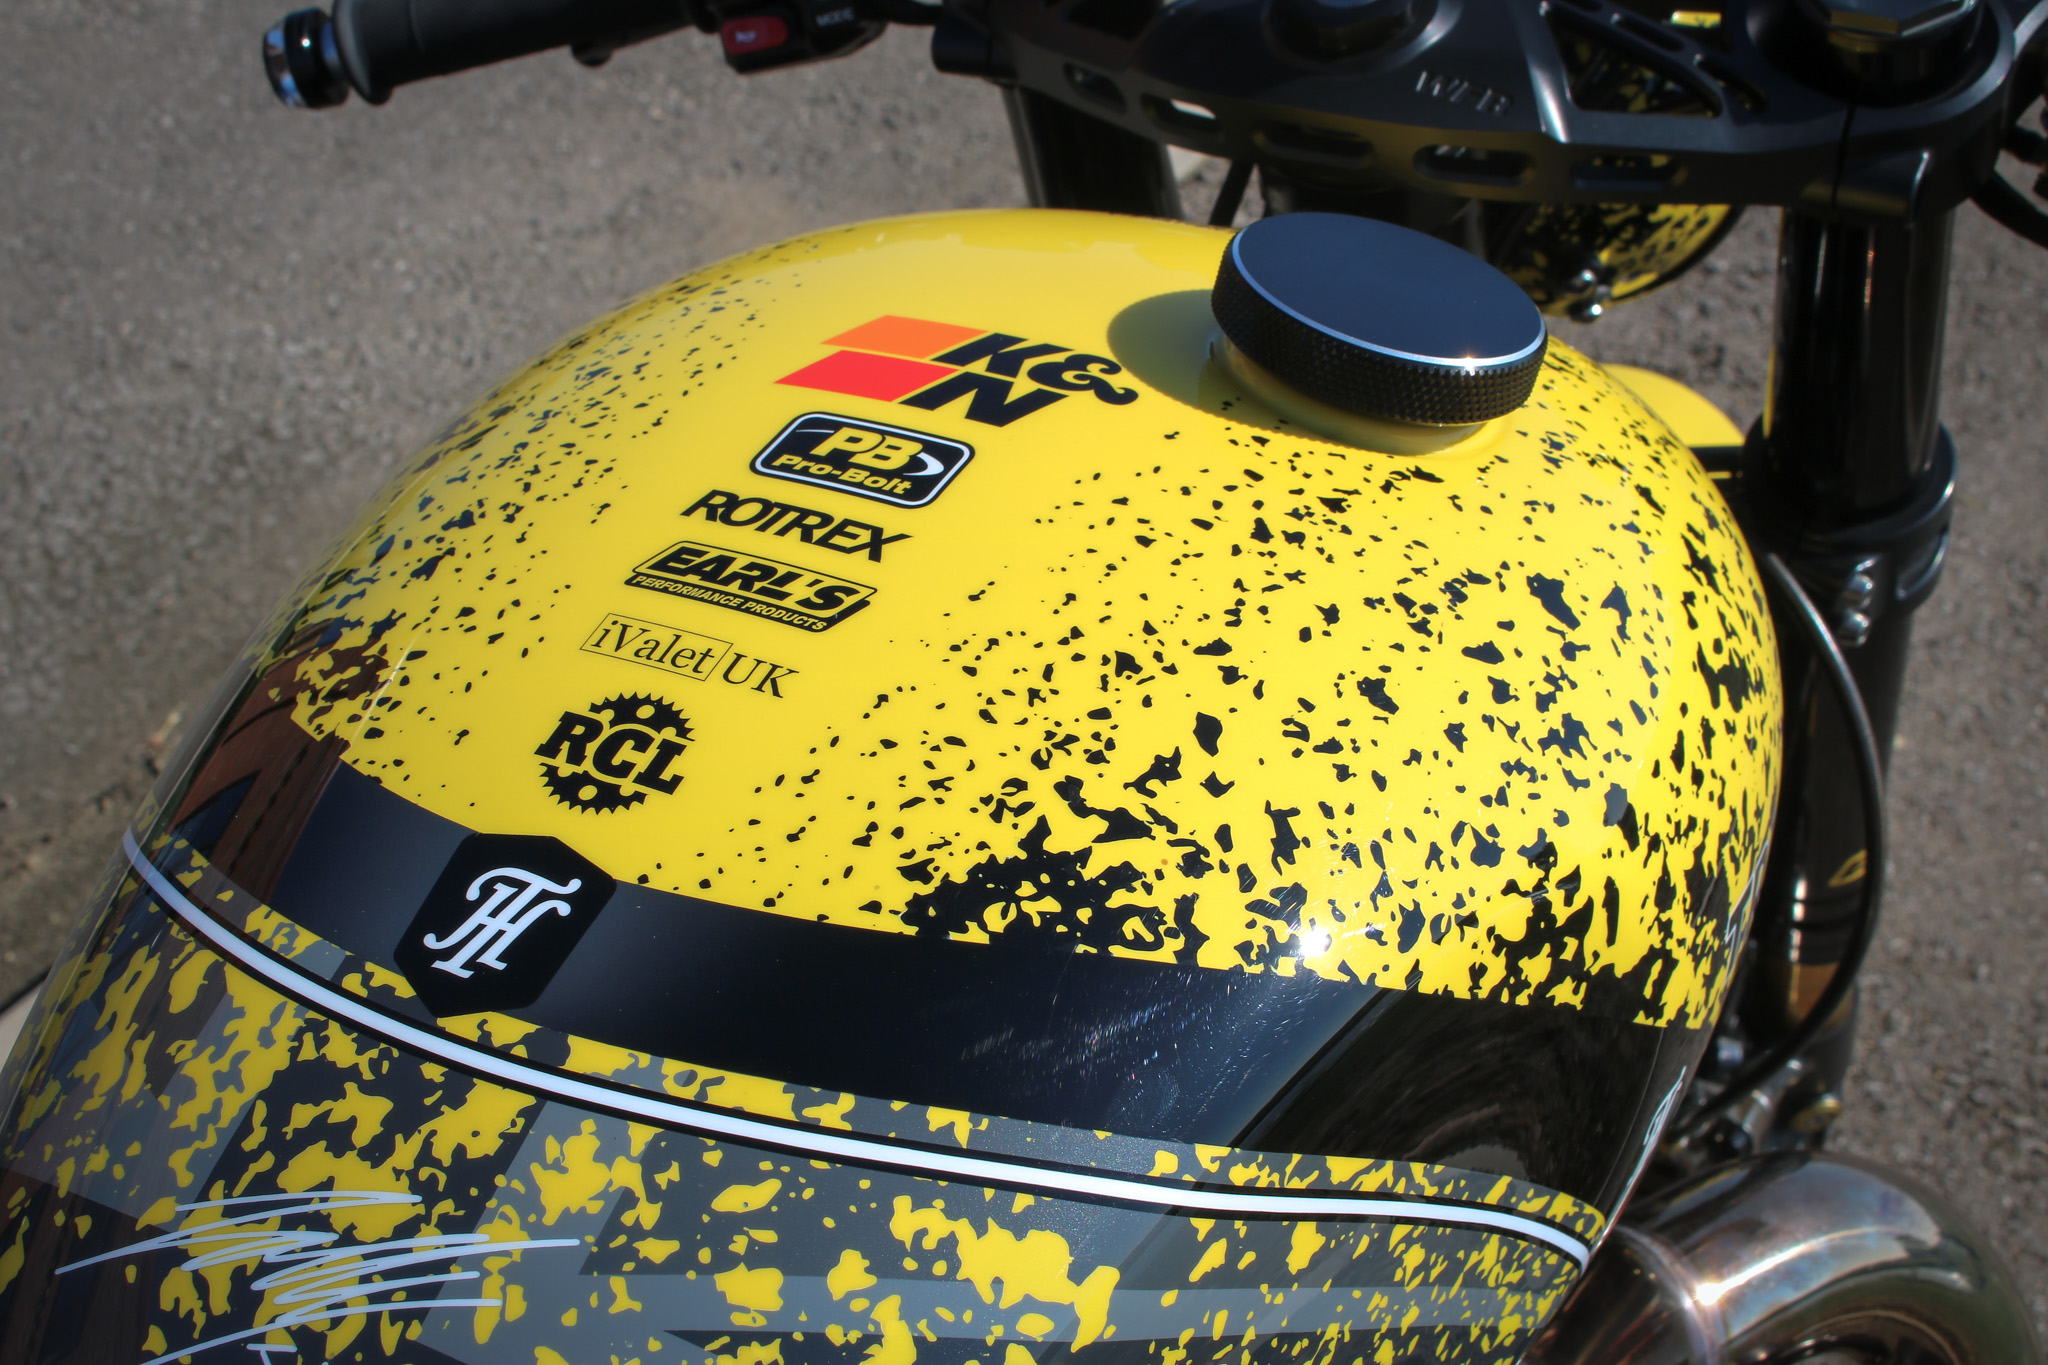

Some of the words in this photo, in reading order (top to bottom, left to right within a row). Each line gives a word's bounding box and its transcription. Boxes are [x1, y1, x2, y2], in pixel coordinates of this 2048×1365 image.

[771, 454, 912, 495] Pro-Bolt
[810, 427, 923, 471] PB
[680, 489, 914, 563] ROTREX
[632, 575, 743, 608] PERFORMANCE
[741, 601, 828, 630] PRODUCTS
[645, 546, 862, 611] EARL'S
[591, 620, 715, 674] iValet
[722, 652, 800, 699] UK
[534, 711, 687, 795] RCL
